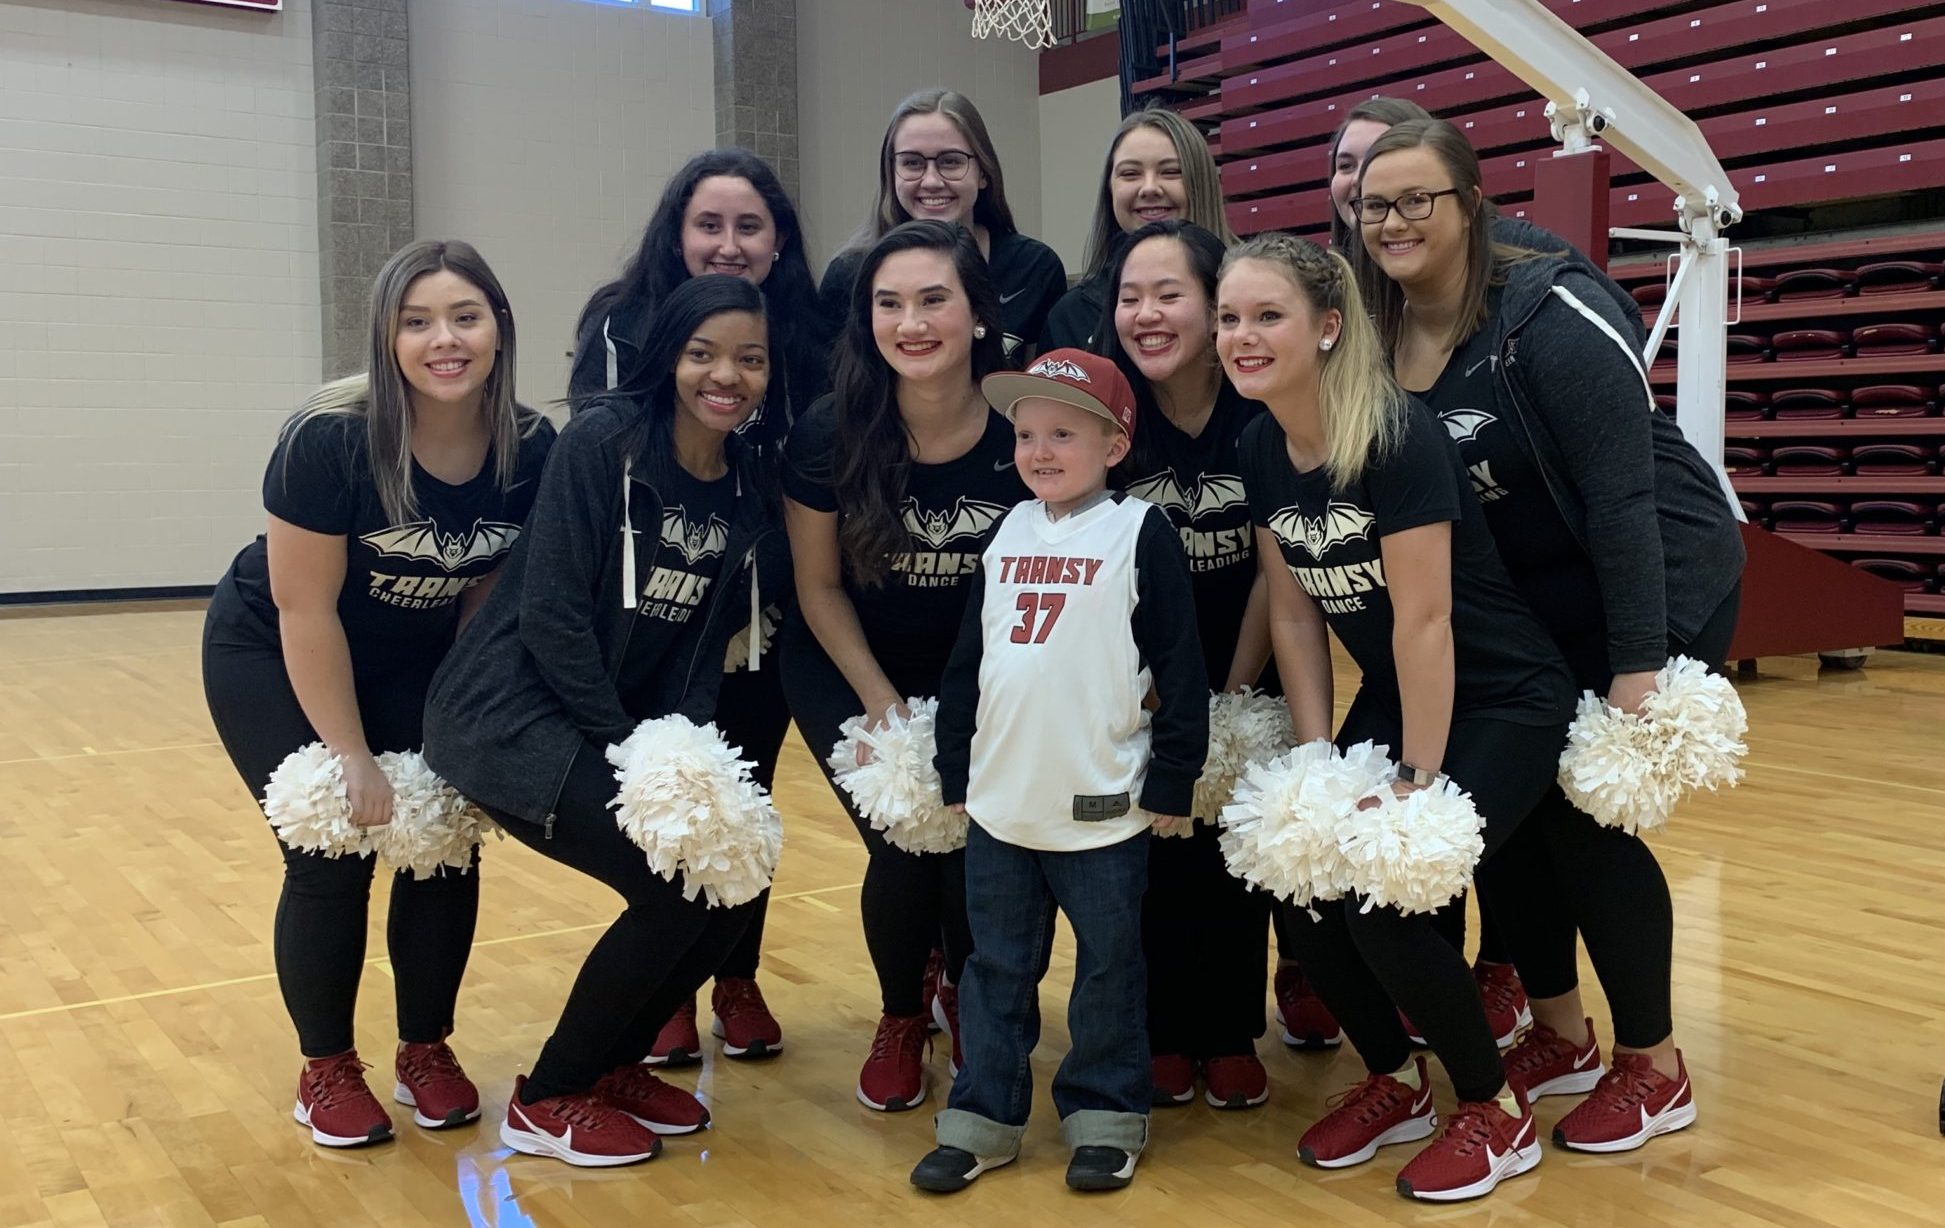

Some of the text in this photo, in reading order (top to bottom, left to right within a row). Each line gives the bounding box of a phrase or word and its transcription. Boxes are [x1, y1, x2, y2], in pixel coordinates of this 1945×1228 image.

[1179, 520, 1251, 558] ANSY
[999, 556, 1105, 586] TRANSY
[1189, 550, 1250, 572] LEADING
[369, 570, 486, 598] TRANS
[642, 565, 712, 606] RANS
[908, 574, 960, 587] DANCE
[1009, 592, 1067, 645] 37
[1320, 596, 1367, 614] DANCE
